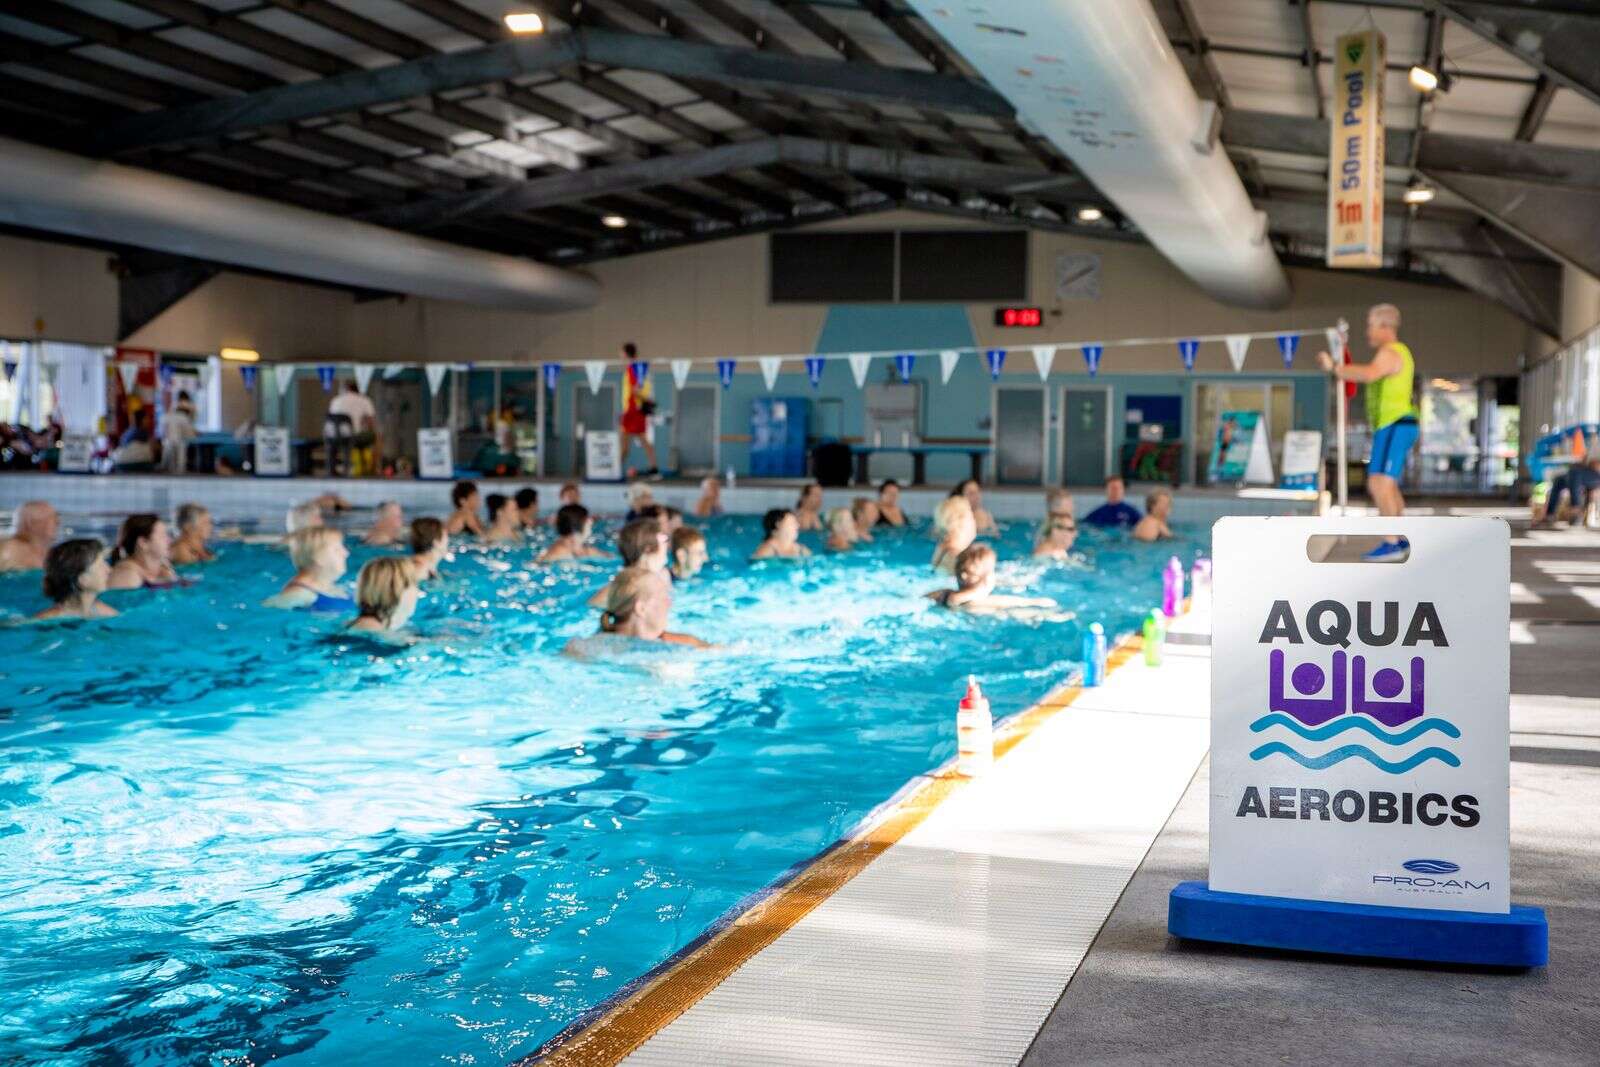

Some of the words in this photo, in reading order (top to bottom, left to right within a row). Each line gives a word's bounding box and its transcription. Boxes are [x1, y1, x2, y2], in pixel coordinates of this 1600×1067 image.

[1343, 69, 1365, 127] Pool
[1341, 136, 1362, 191] 50m
[1335, 200, 1363, 225] 1m
[1258, 599, 1449, 649] AQUA
[1236, 786, 1480, 828] AEROBICS
[1372, 875, 1490, 891] PRO-AM
